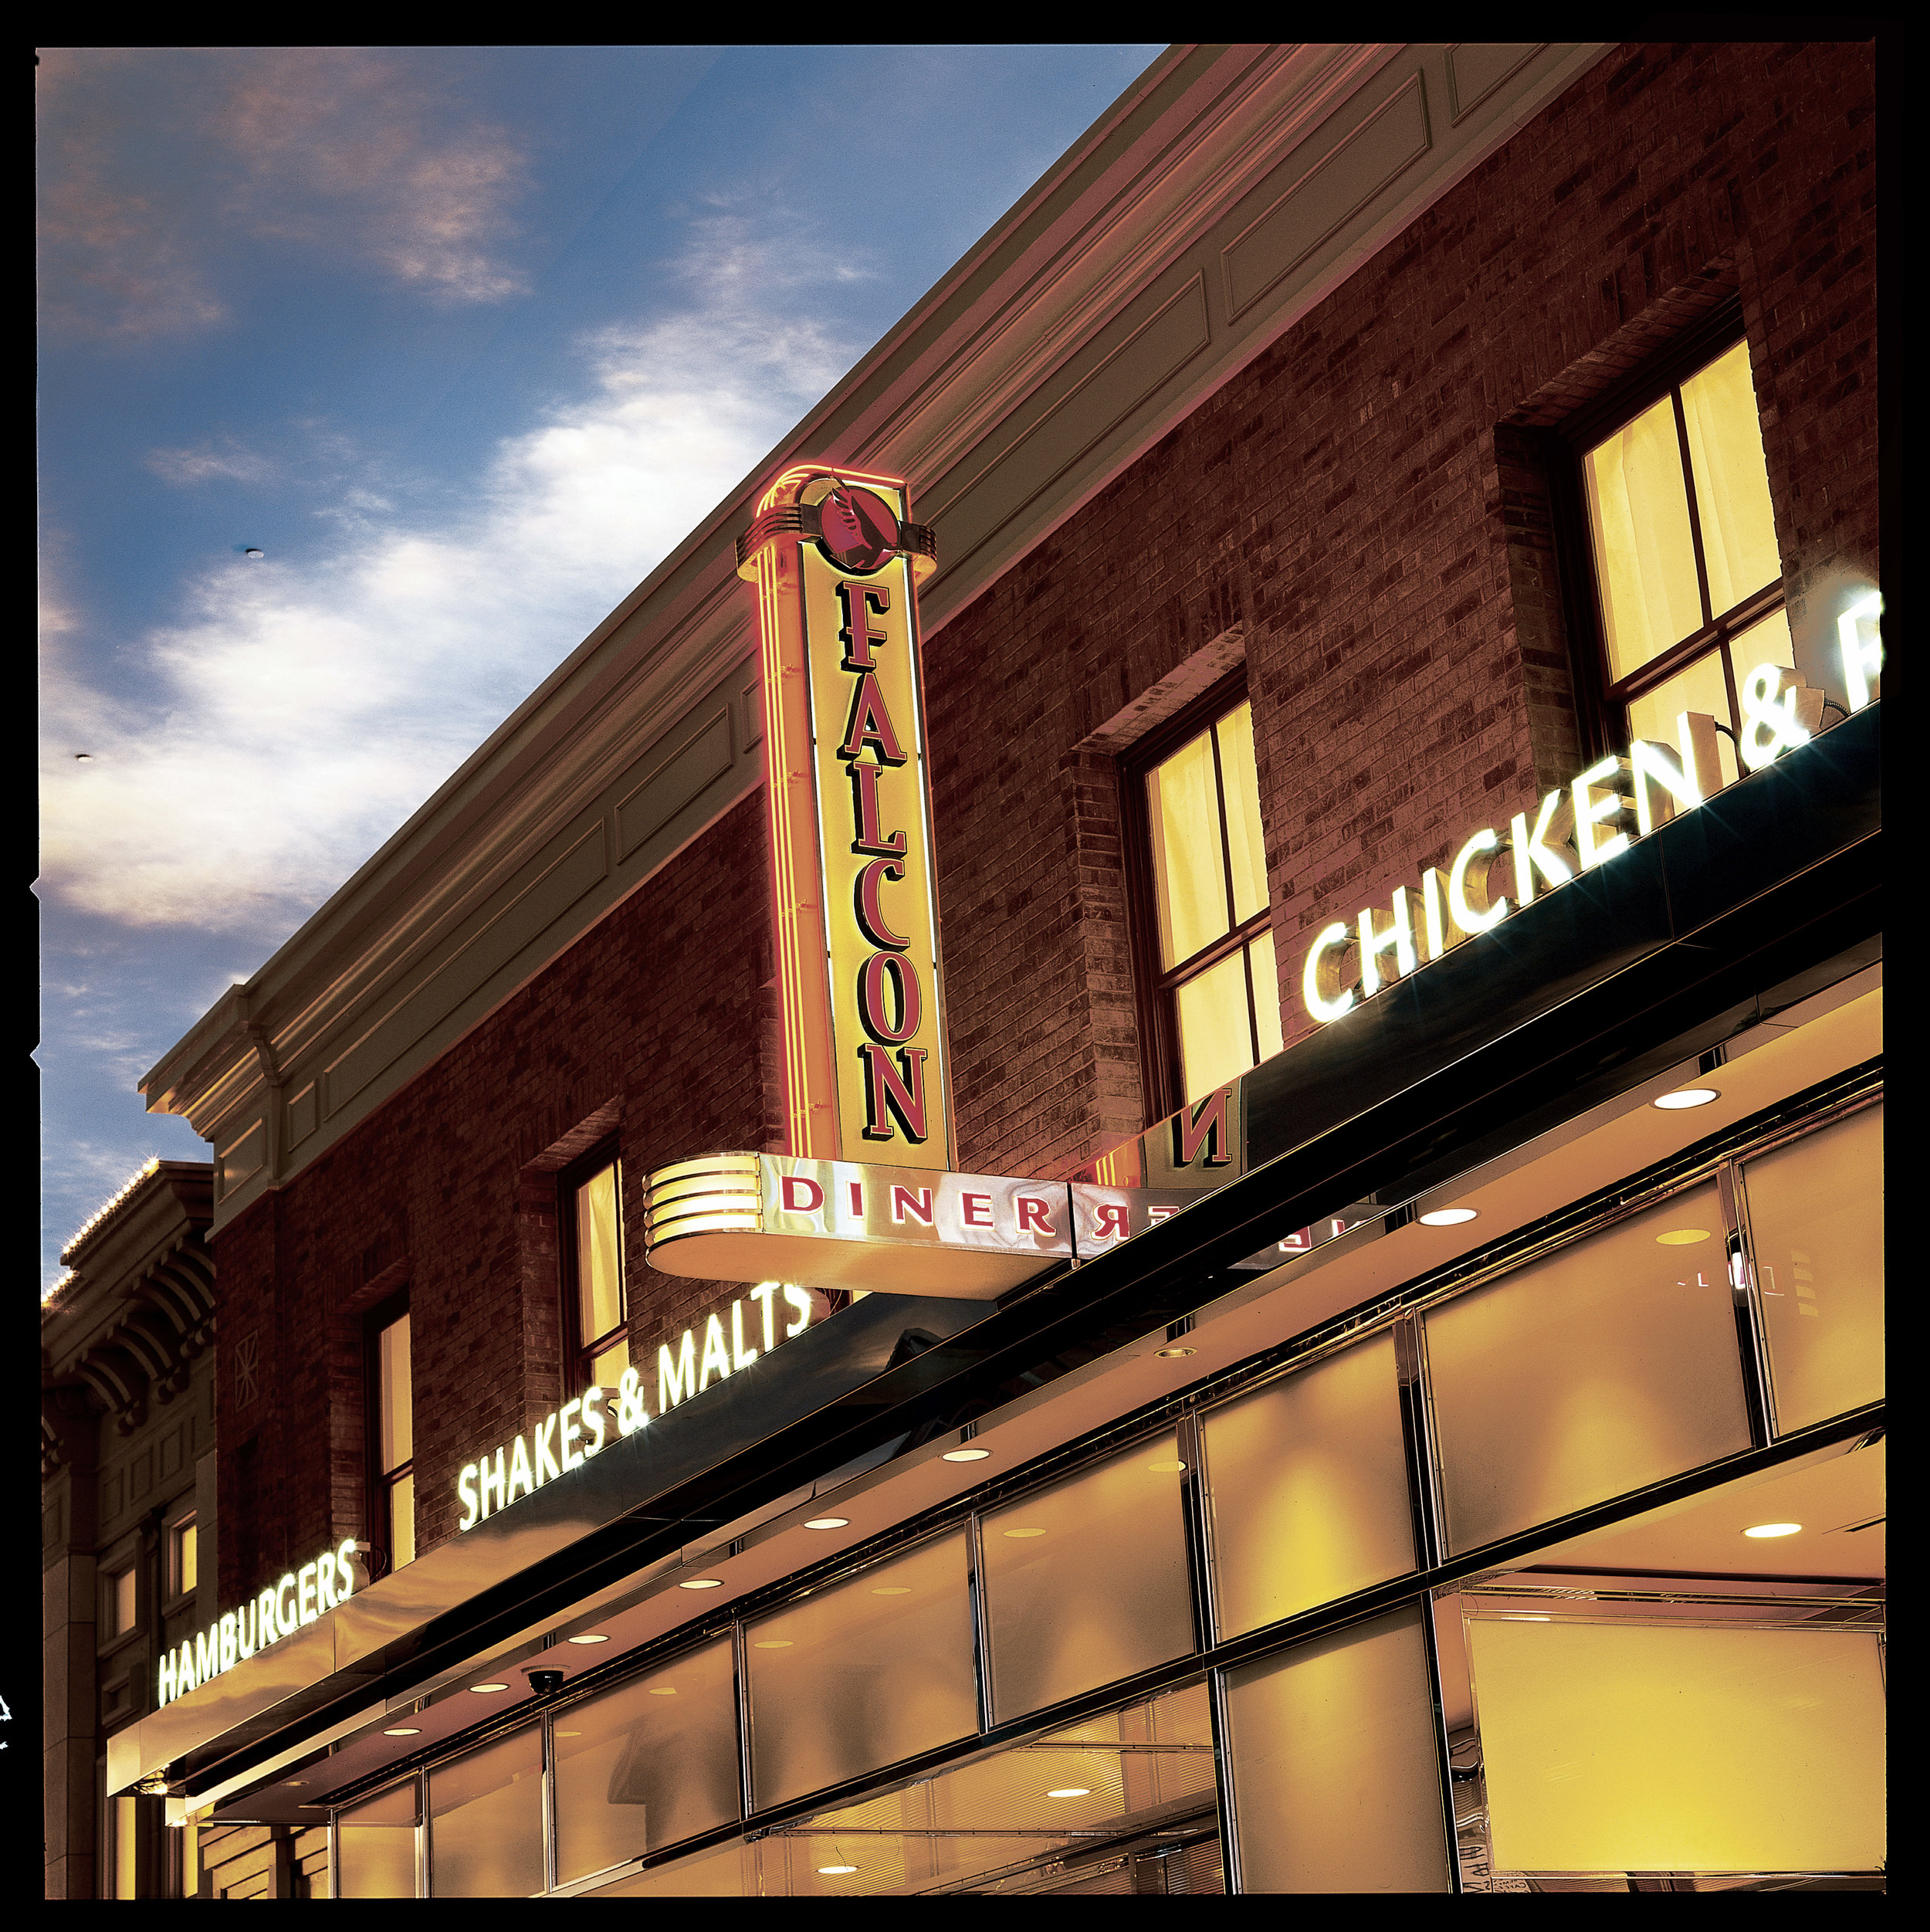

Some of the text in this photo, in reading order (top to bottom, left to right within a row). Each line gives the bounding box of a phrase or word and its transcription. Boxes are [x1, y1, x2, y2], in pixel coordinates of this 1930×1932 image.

[836, 580, 927, 1144] FALCON
[1302, 710, 1704, 1023] CHICKEN
[1740, 663, 1810, 771] &
[778, 1175, 1056, 1237] DINER
[458, 1281, 812, 1532] SHAKES & MALTS
[157, 1538, 357, 1709] HAMBURGERS
